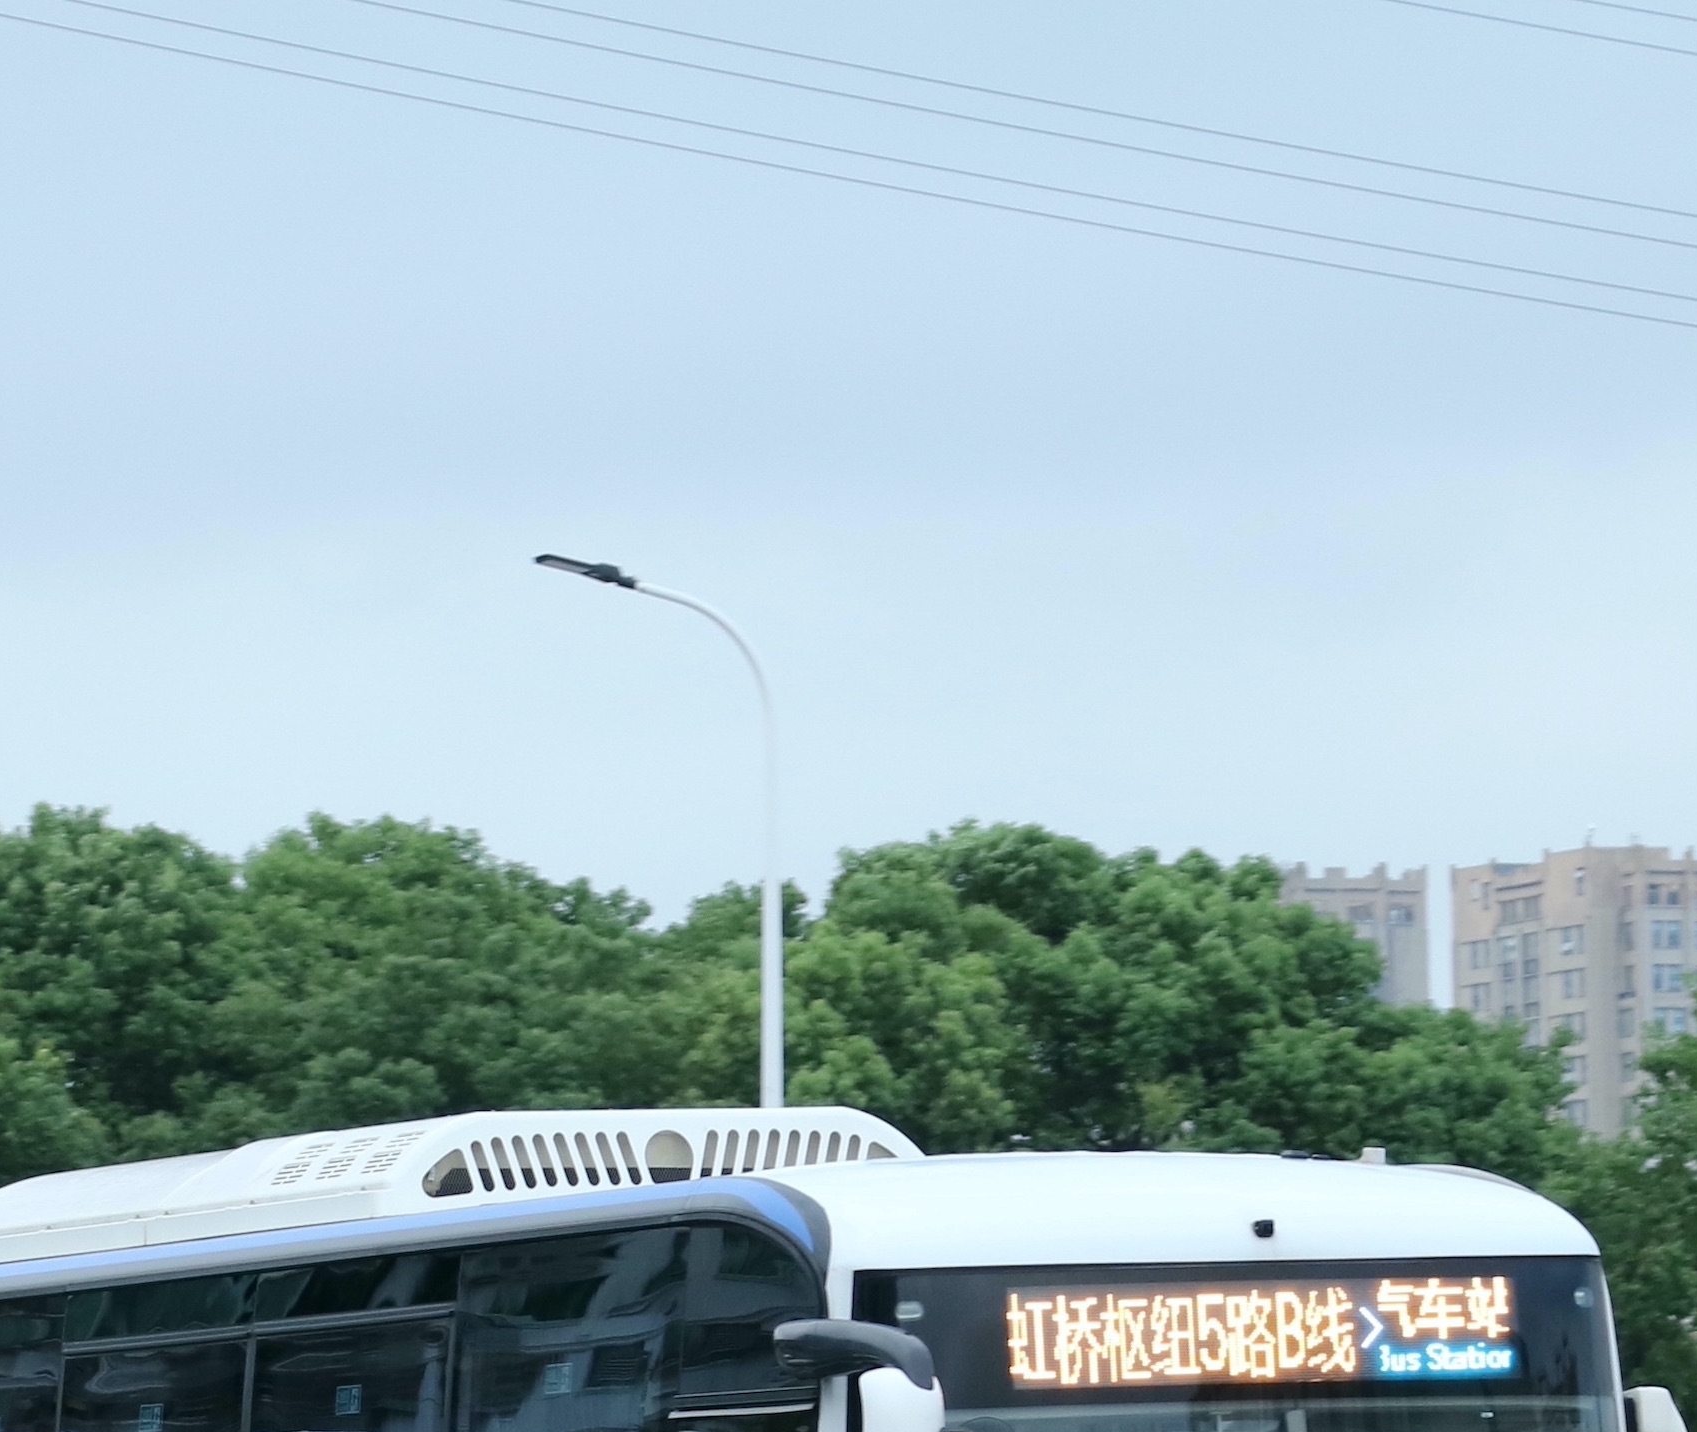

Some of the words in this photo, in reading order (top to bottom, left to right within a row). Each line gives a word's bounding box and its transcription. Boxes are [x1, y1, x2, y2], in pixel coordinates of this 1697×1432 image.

[1006, 1287, 1356, 1384] 虹桥枢纽5路B线
